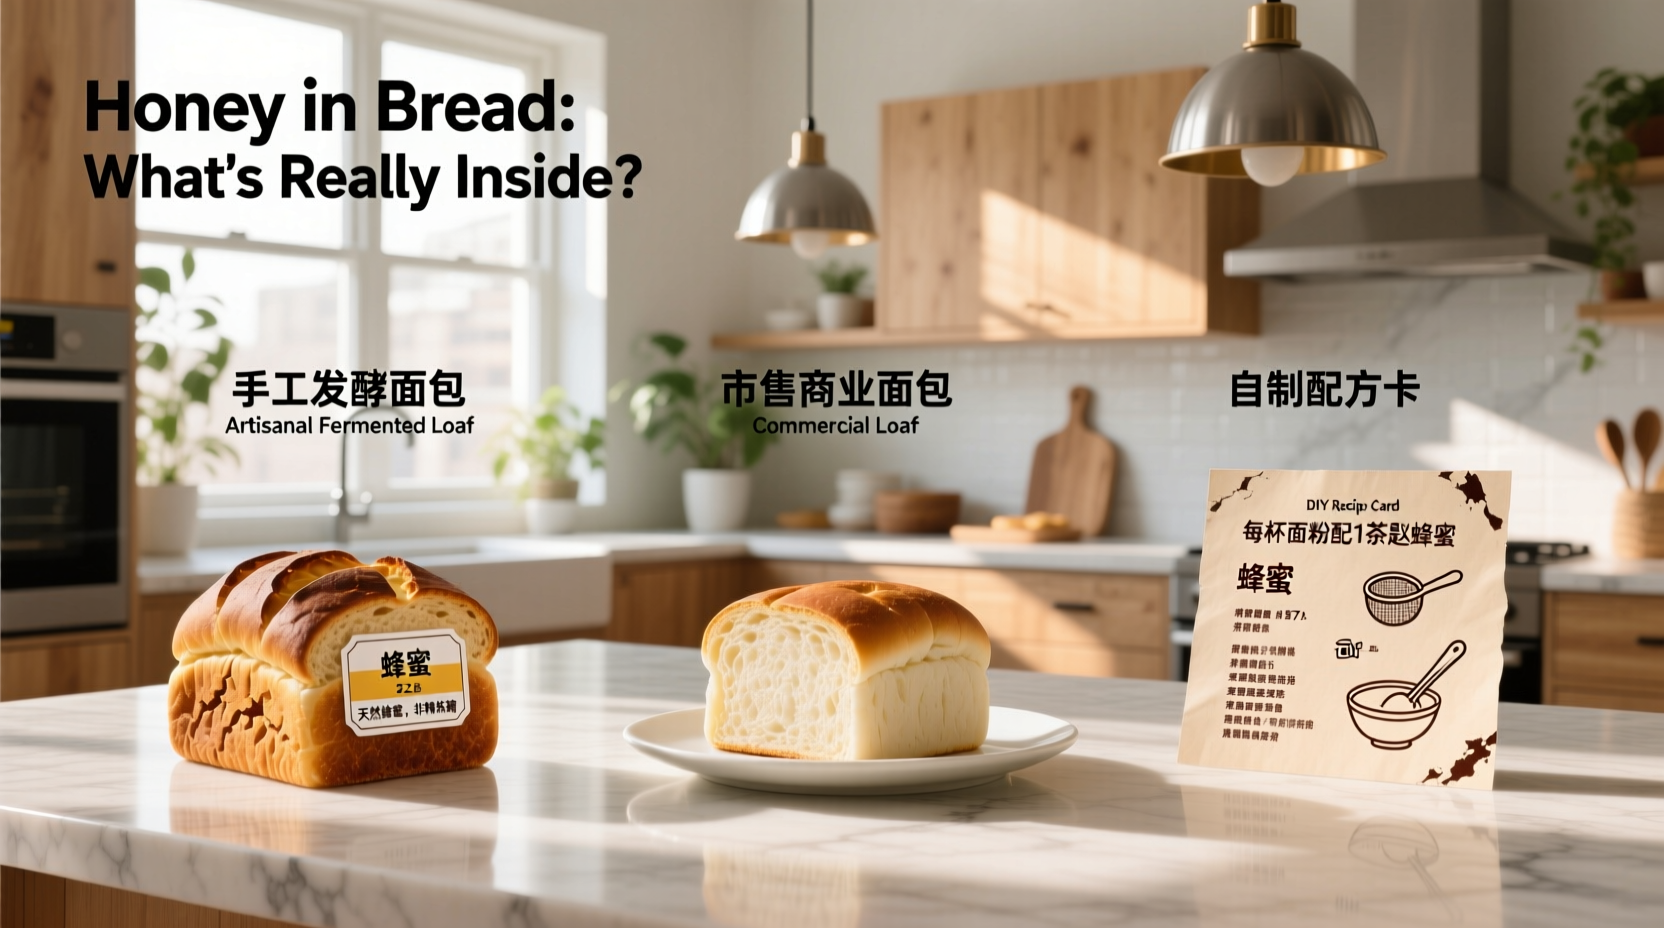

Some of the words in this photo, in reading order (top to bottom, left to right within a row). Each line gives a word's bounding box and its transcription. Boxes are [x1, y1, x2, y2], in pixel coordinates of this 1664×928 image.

[1306, 499, 1330, 511] DIY
[1370, 498, 1400, 512] Card
[1236, 562, 1295, 596] 蜂蜜
[380, 647, 432, 679] 蜂蜜
